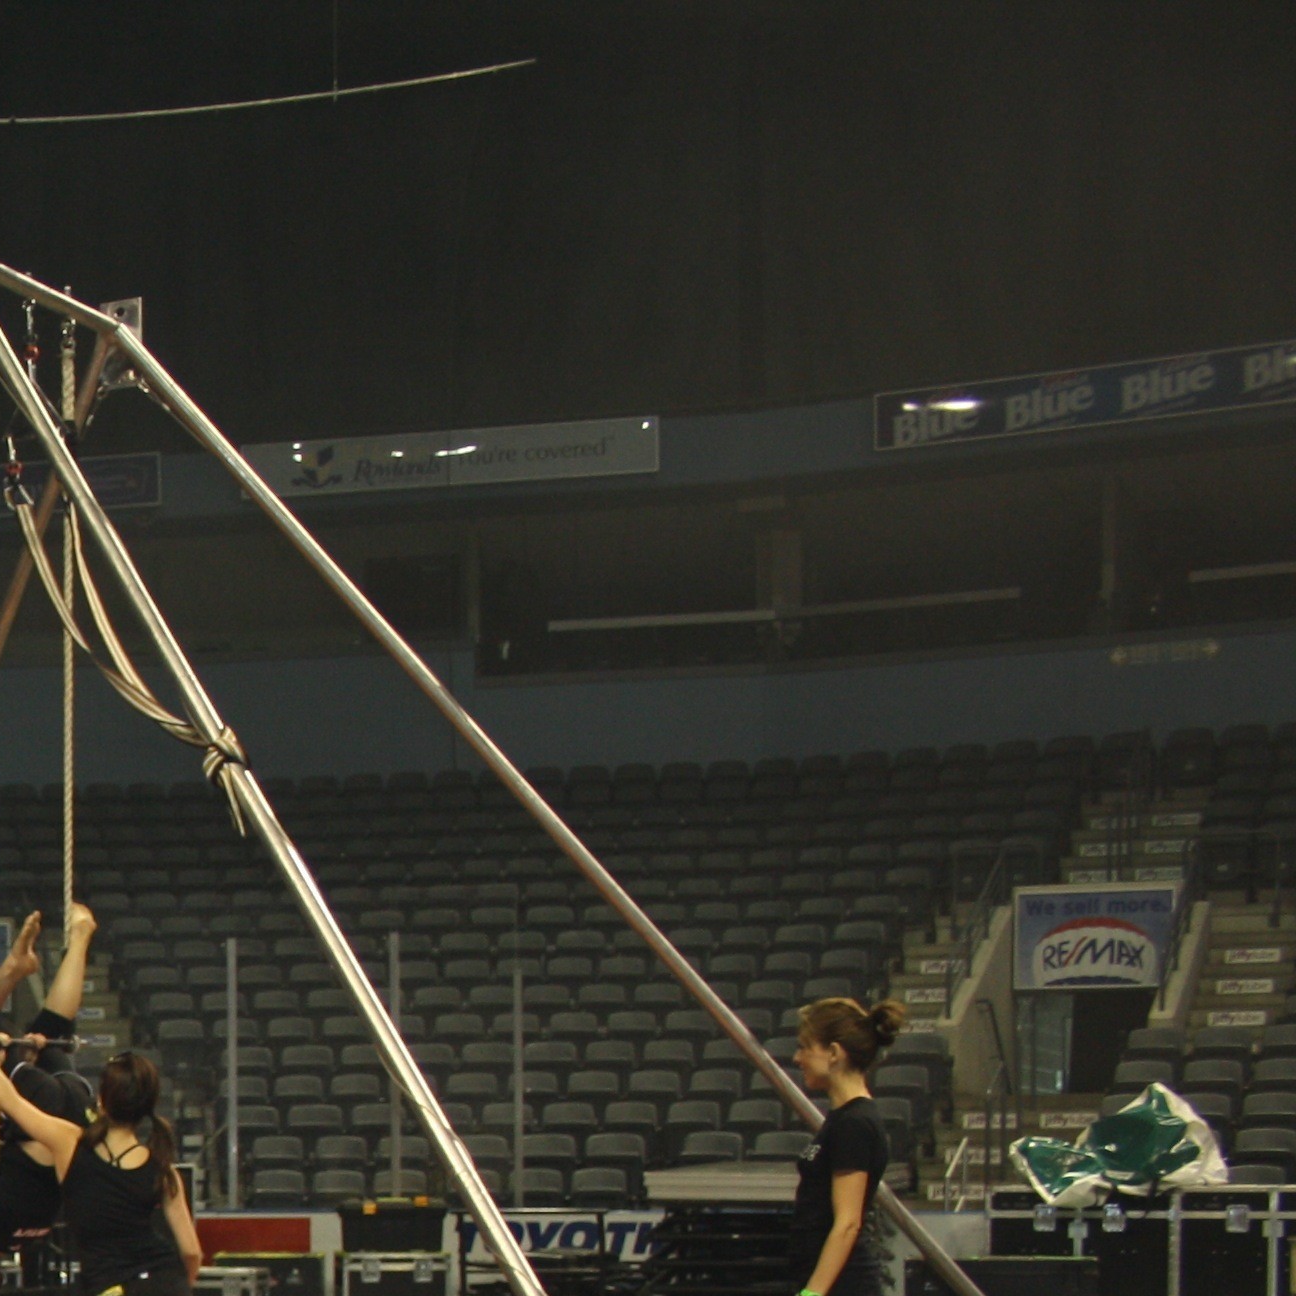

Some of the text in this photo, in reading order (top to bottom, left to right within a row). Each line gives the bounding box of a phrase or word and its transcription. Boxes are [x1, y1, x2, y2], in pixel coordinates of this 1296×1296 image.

[1008, 382, 1095, 432] Blue
[1119, 360, 1216, 413] Blue
[524, 436, 608, 464] covered
[1042, 936, 1146, 972] RE/MAX
